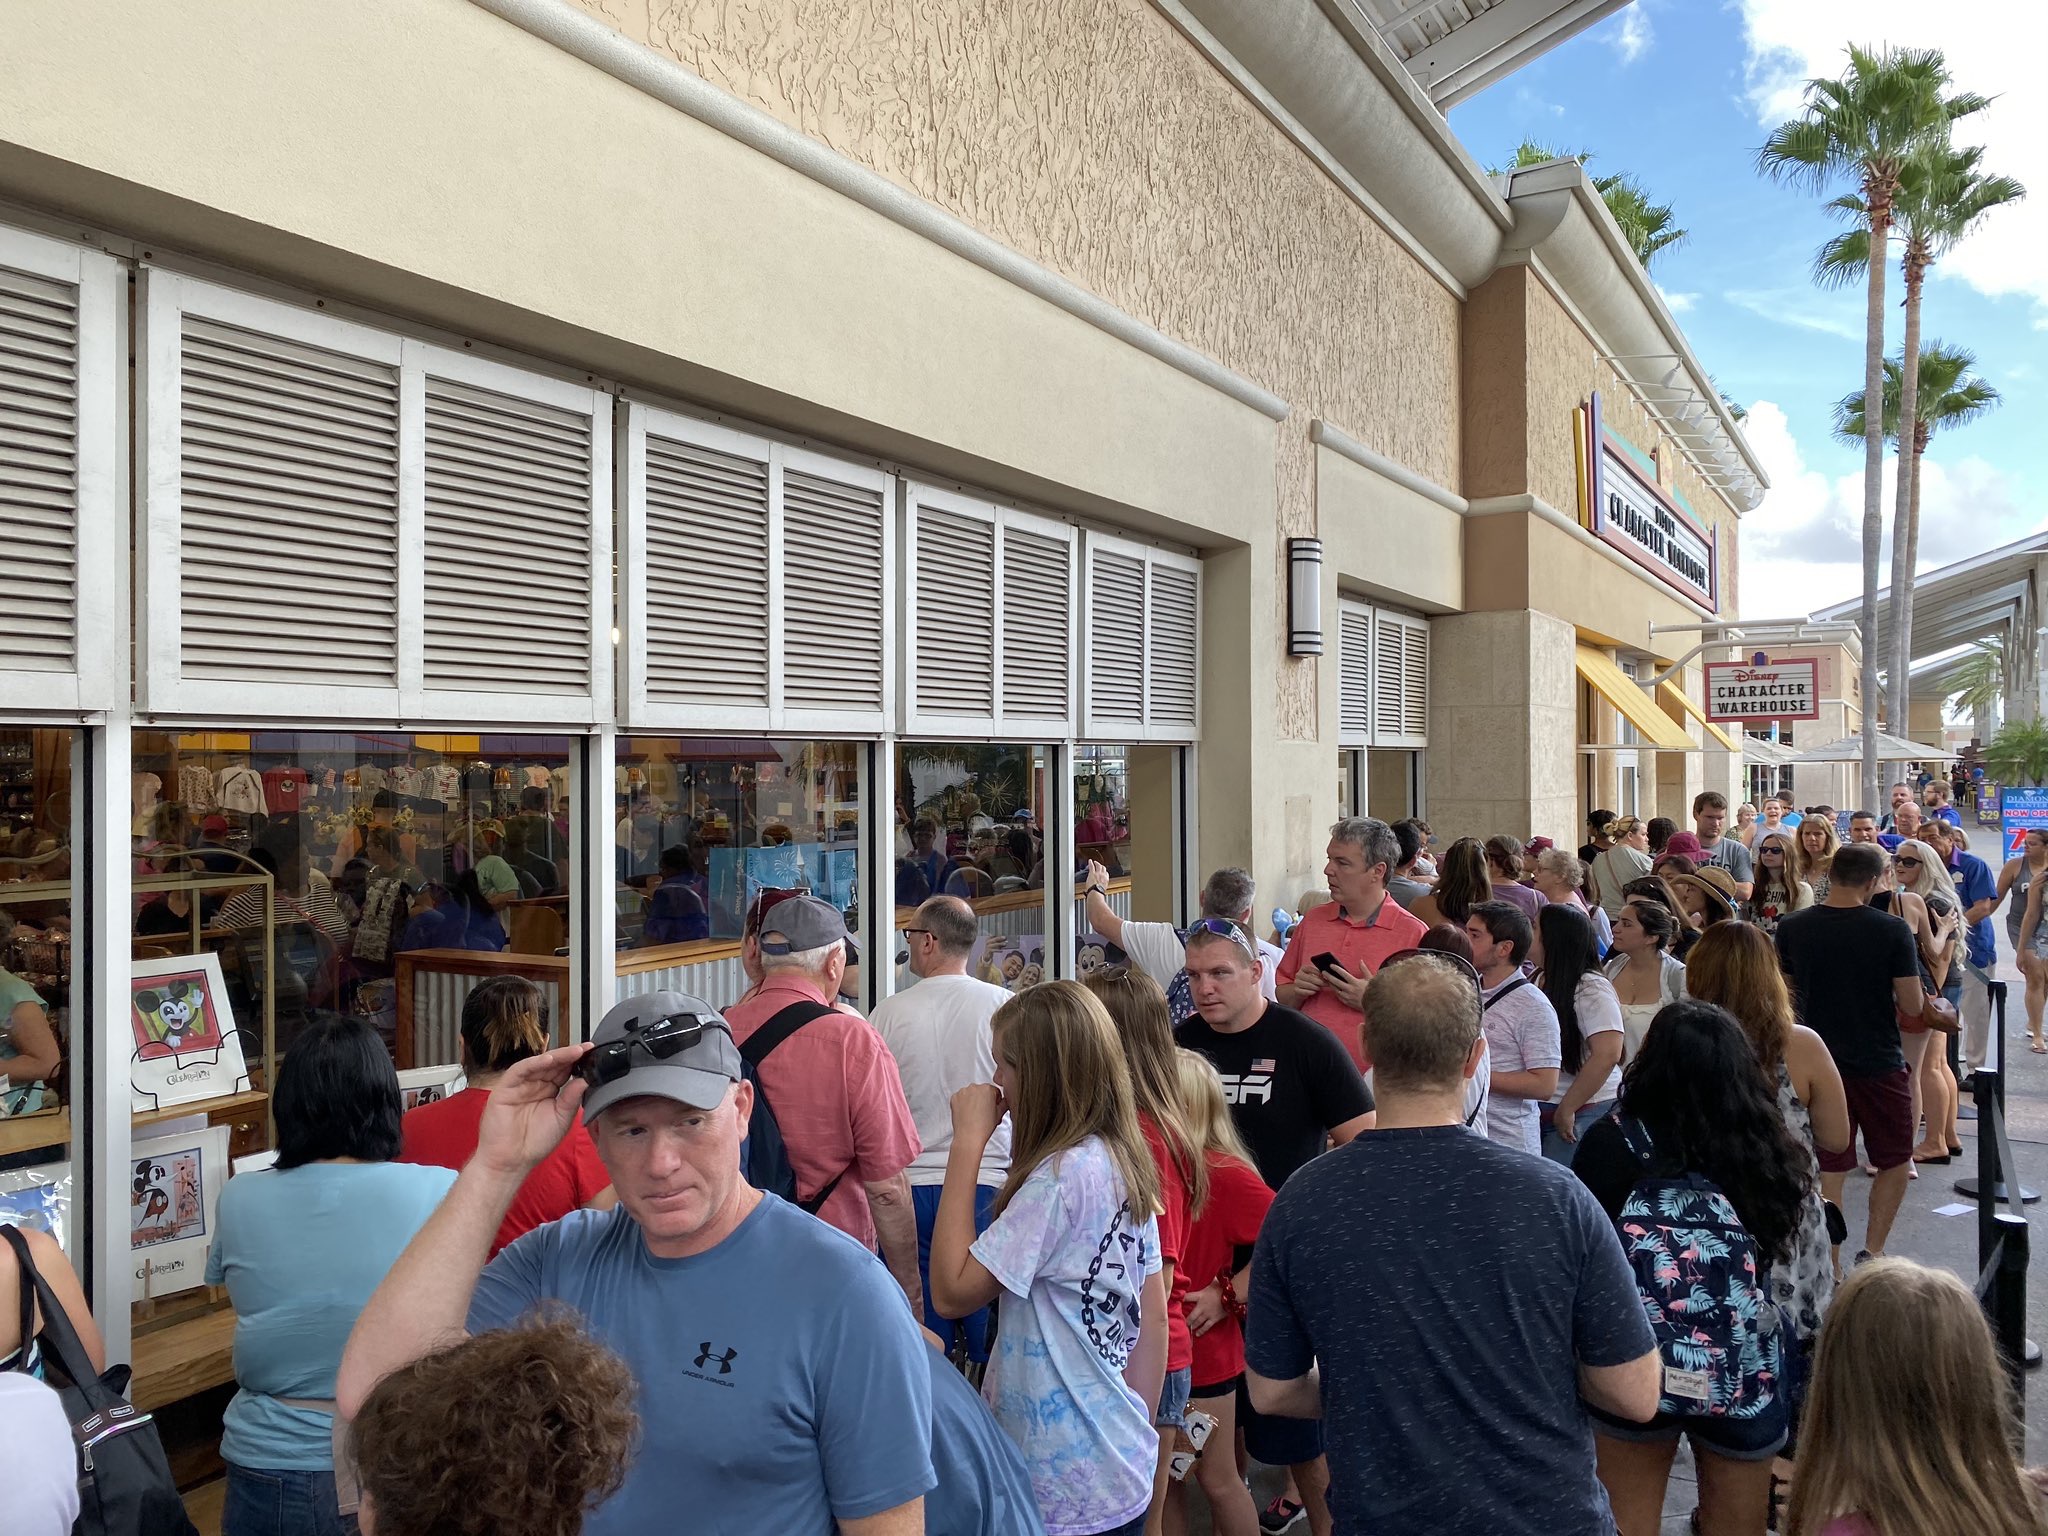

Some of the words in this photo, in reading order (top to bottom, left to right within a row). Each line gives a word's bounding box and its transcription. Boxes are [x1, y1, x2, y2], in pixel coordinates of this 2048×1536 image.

[1610, 492, 1665, 558] CHARACTER
[1717, 683, 1805, 698] CHARACTER
[1717, 700, 1807, 714] WAREHOUSE
[1979, 810, 2000, 820] $29
[2004, 809, 2029, 817] NOW
[681, 1369, 704, 1380] UNDER
[703, 1376, 735, 1388] ARMOUR
